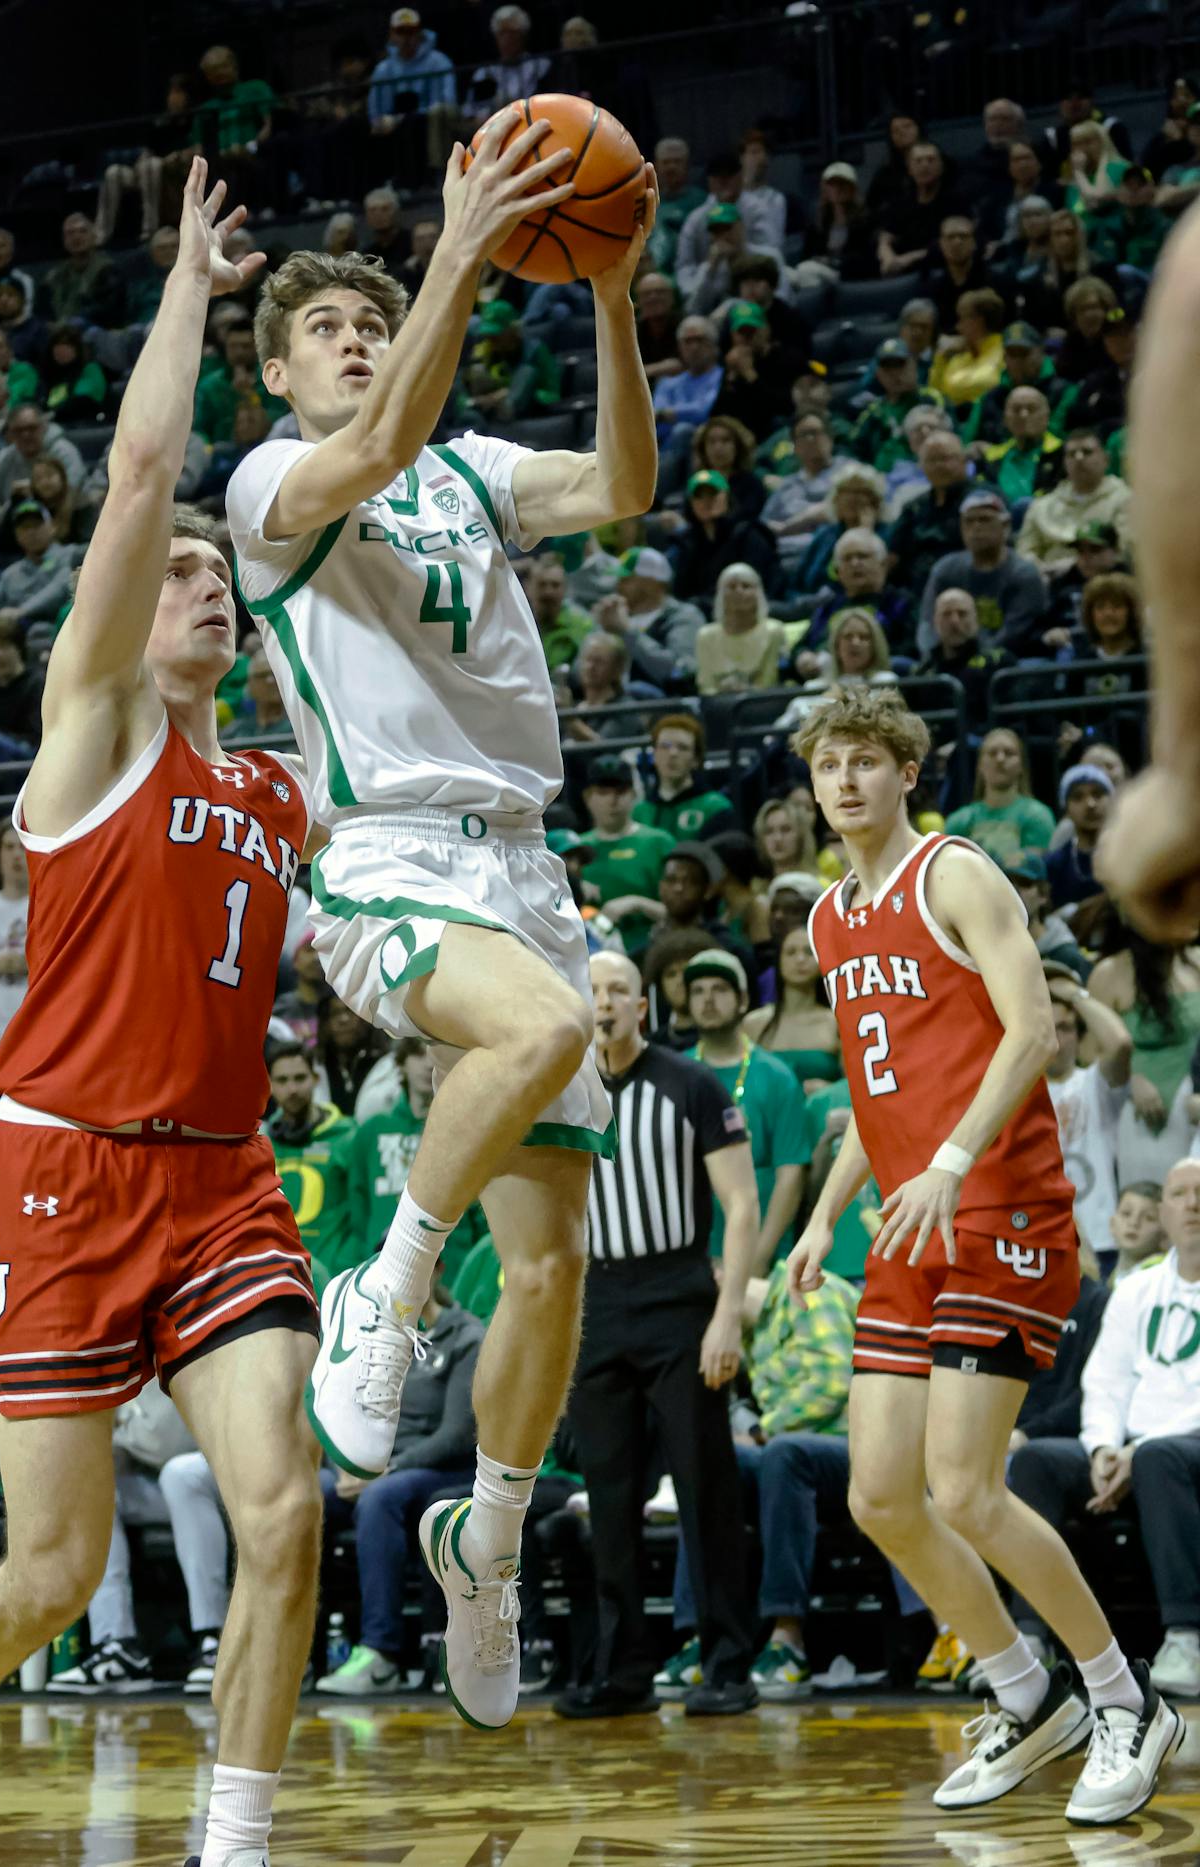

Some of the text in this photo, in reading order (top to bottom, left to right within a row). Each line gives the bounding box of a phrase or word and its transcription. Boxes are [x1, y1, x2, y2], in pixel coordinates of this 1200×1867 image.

[359, 521, 489, 556] DUCKS
[419, 560, 472, 653] 4
[167, 795, 299, 903] UTAH
[461, 813, 487, 839] O
[207, 876, 251, 989] 1
[856, 1009, 899, 1097] 2
